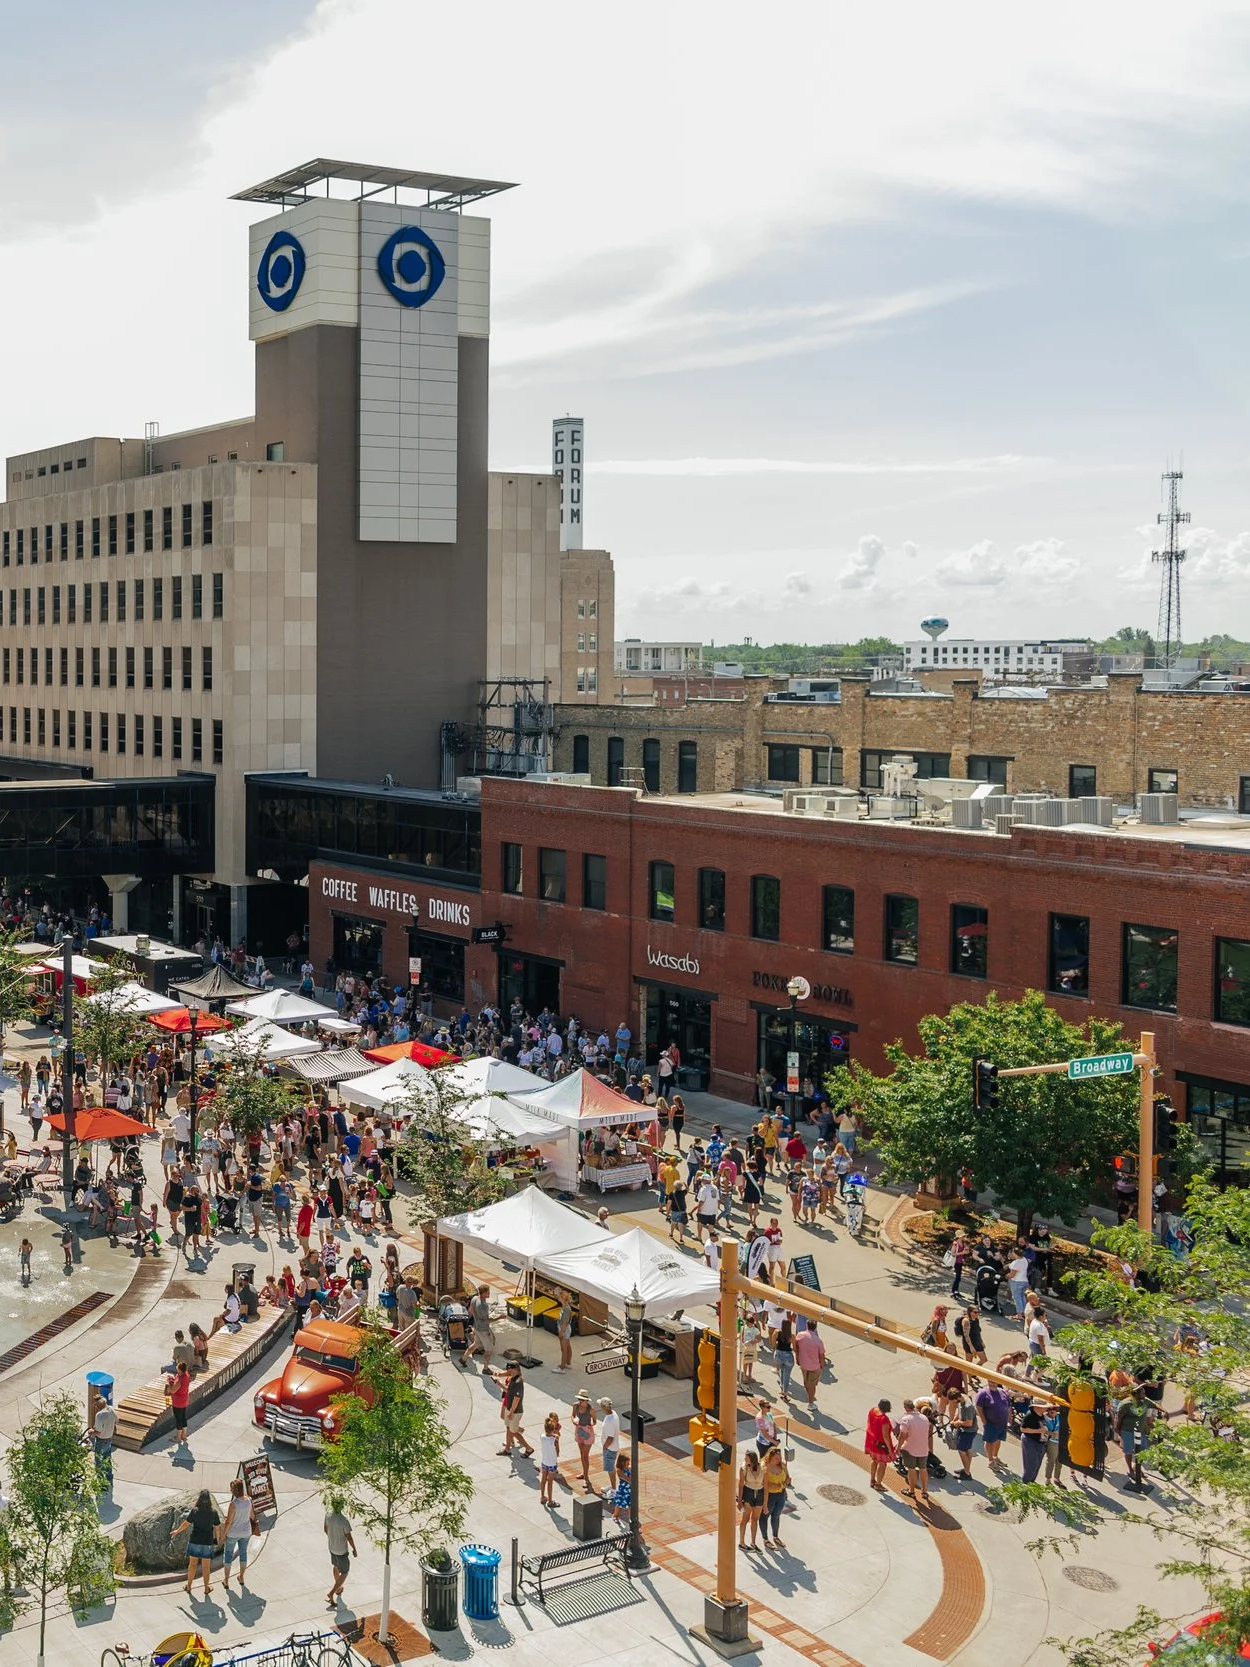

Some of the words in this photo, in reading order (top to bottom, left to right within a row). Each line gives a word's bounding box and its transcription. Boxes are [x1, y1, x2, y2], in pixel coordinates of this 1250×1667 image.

[570, 430, 581, 524] FORUM
[322, 877, 358, 903] COFFEE
[369, 886, 417, 914] WAFFLES
[429, 898, 470, 926] DRINKS
[813, 984, 852, 1006] BOWL
[1073, 1057, 1130, 1075] Broadway
[620, 1113, 638, 1122] MADE
[662, 1268, 688, 1280] MARKET
[589, 1357, 626, 1371] BROADWAY
[245, 1458, 265, 1468] WELCOME
[251, 1483, 269, 1495] MARKET
